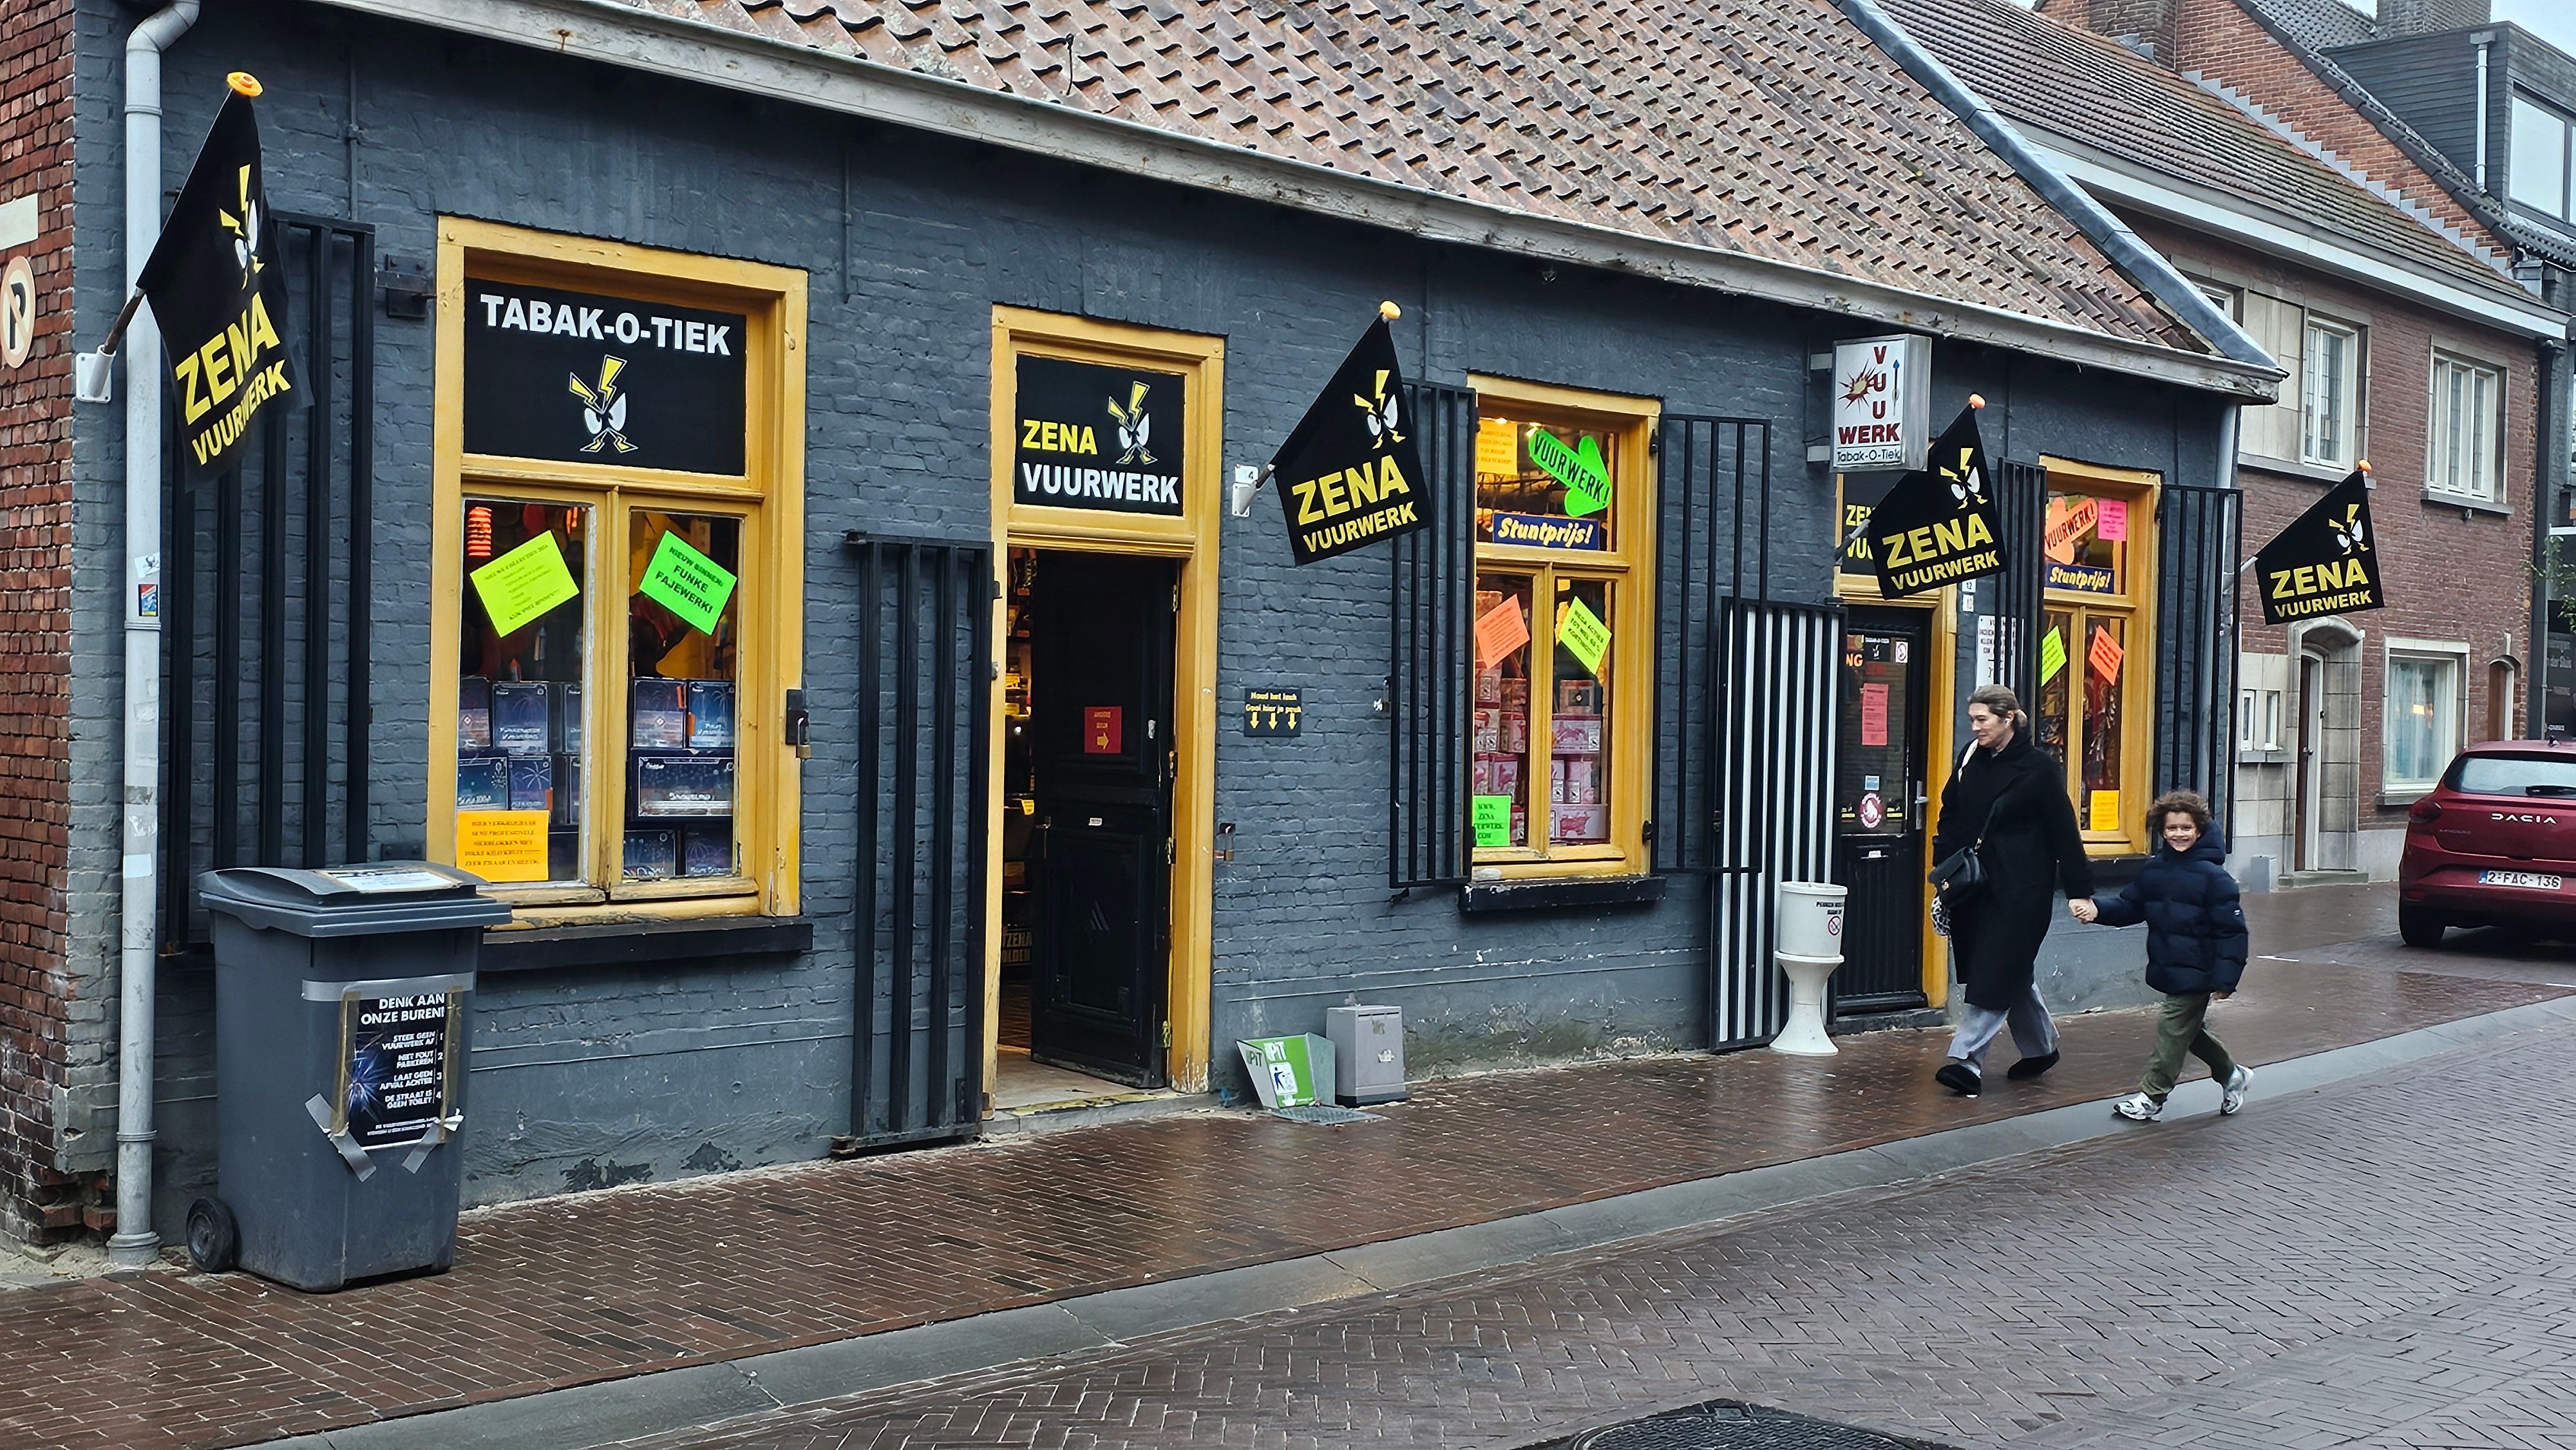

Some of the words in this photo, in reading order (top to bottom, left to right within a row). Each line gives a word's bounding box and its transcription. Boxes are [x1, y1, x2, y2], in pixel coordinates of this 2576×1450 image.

[480, 294, 730, 355] TABAK-O-TIEK
[176, 292, 280, 426] ZENA
[192, 359, 292, 465] VUURWERK
[1022, 419, 1098, 455] ZENA
[1838, 422, 1900, 444] WERK
[1534, 434, 1610, 506] VUURWERK!
[1837, 448, 1900, 462] Tabak-O-Tiek
[1022, 463, 1179, 504] VUURWERK
[1292, 455, 1410, 525] ZENA
[1303, 501, 1417, 552] VUURWERK
[1498, 517, 1593, 547] Stuntprijs!
[1882, 513, 1993, 569] ZENA
[2045, 504, 2096, 550] VUURWERK!
[673, 565, 708, 593] FUNKE
[1891, 550, 1999, 590] VUURWERK
[2050, 566, 2111, 591] Stuntprijs!
[2270, 558, 2369, 599] ZENA
[2275, 590, 2372, 617] VUURWERK
[2492, 813, 2556, 824] DACIA
[2488, 872, 2560, 888] 2-FAC-136
[361, 1011, 398, 1025] ONZE
[379, 995, 416, 1010] DENK
[417, 993, 445, 1006] AAN
